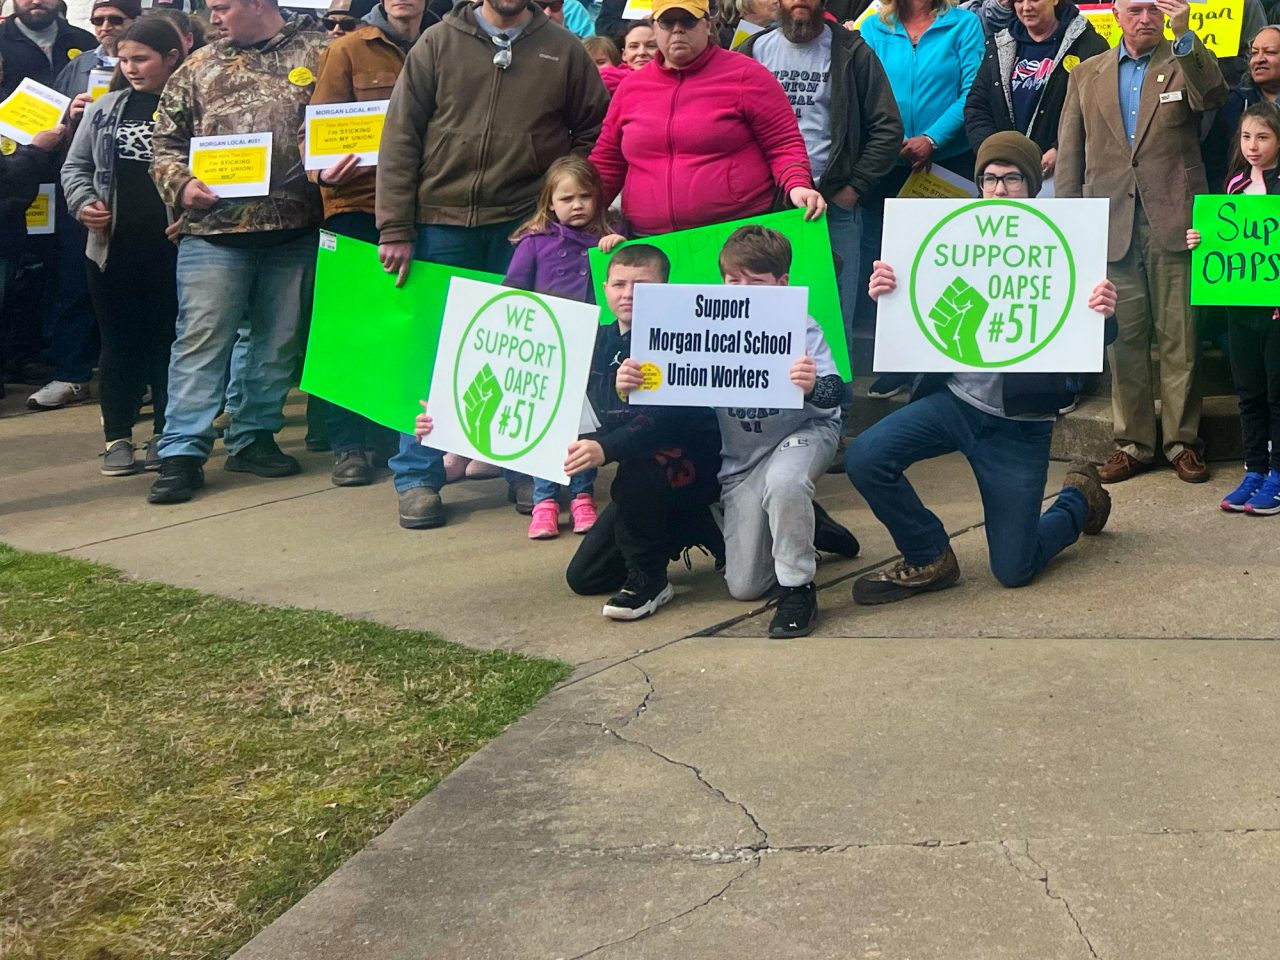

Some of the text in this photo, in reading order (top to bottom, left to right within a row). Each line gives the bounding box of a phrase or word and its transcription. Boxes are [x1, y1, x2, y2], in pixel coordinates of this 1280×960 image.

[773, 70, 830, 82] UPPORT
[781, 82, 818, 92] NION
[787, 95, 815, 106] CAL
[975, 214, 1020, 238] WE
[934, 244, 1058, 268] SUPPORT
[988, 274, 1052, 300] OAPSE
[506, 304, 536, 332] WE
[695, 294, 750, 320] Support
[988, 304, 1038, 344] #51
[474, 328, 556, 368] SUPPORT
[649, 328, 792, 355] Morgan Local School
[504, 366, 548, 400] OAPSE
[668, 363, 708, 386] Union
[711, 365, 769, 389] Workers
[498, 399, 536, 442] #51
